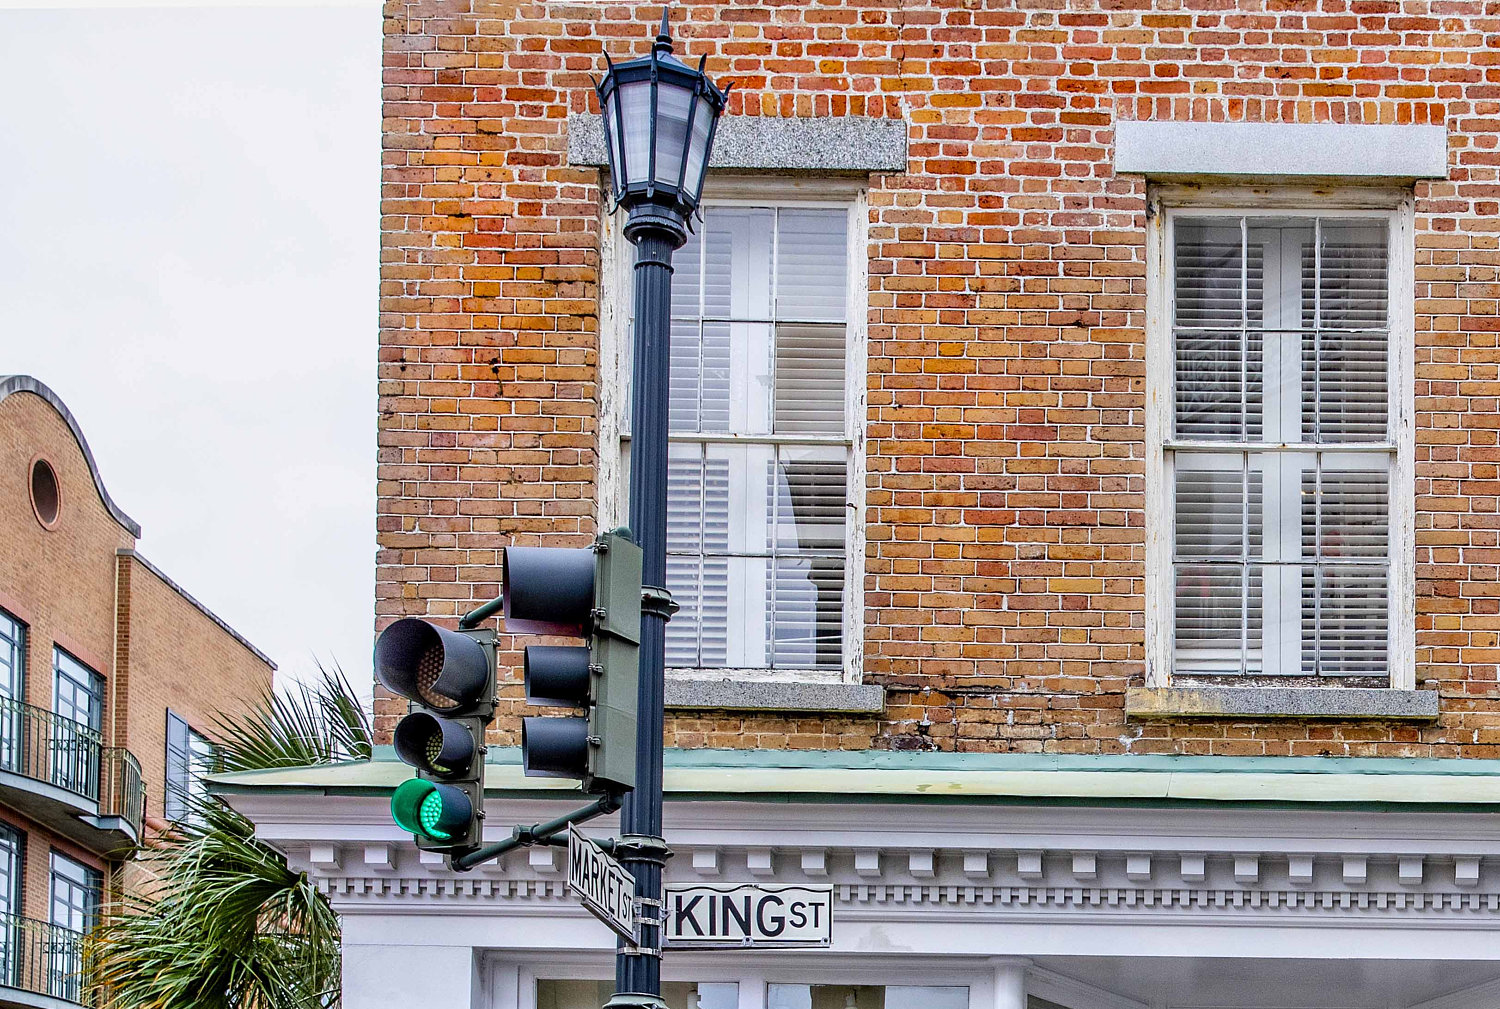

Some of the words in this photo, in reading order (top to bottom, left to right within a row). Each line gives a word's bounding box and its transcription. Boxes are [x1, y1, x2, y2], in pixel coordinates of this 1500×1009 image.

[570, 836, 623, 918] MARKET
[622, 891, 632, 923] ST
[675, 894, 786, 938] KING
[789, 901, 825, 928] ST
